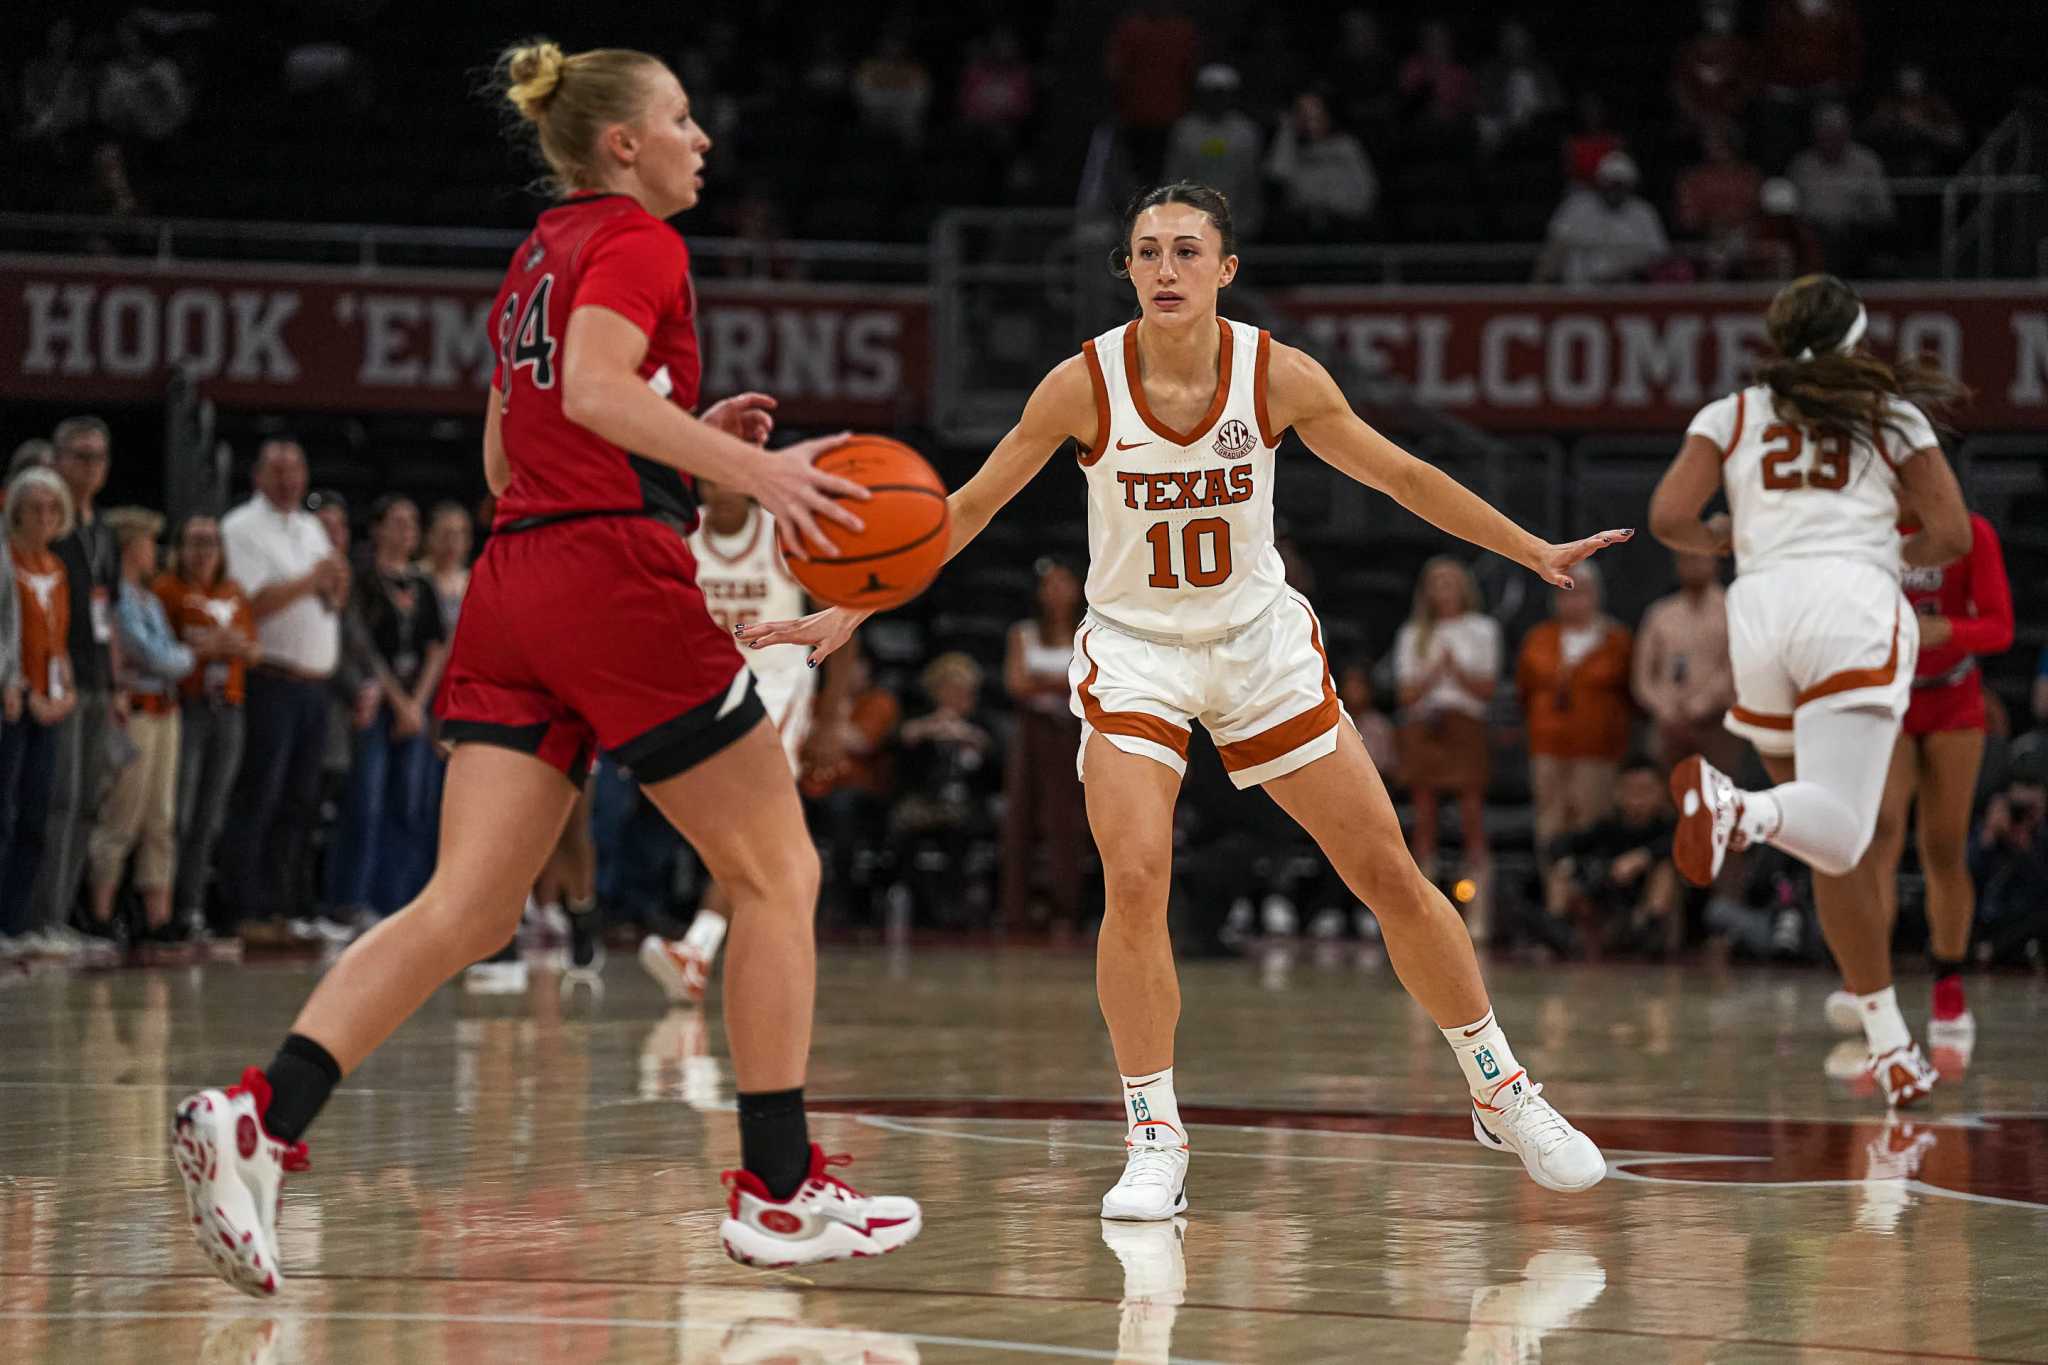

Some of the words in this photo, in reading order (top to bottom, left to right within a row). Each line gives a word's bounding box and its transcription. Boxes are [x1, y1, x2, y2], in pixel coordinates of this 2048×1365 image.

[22, 283, 301, 382] HOOK
[337, 292, 493, 387] 'EM
[705, 306, 902, 400] RNS
[1304, 312, 1770, 406] ELCOME
[1219, 420, 1248, 449] SEC
[1219, 440, 1254, 459] GRADUATE
[1761, 422, 1850, 490] 23
[1117, 464, 1254, 511] TEXAS
[1146, 516, 1233, 589] 10
